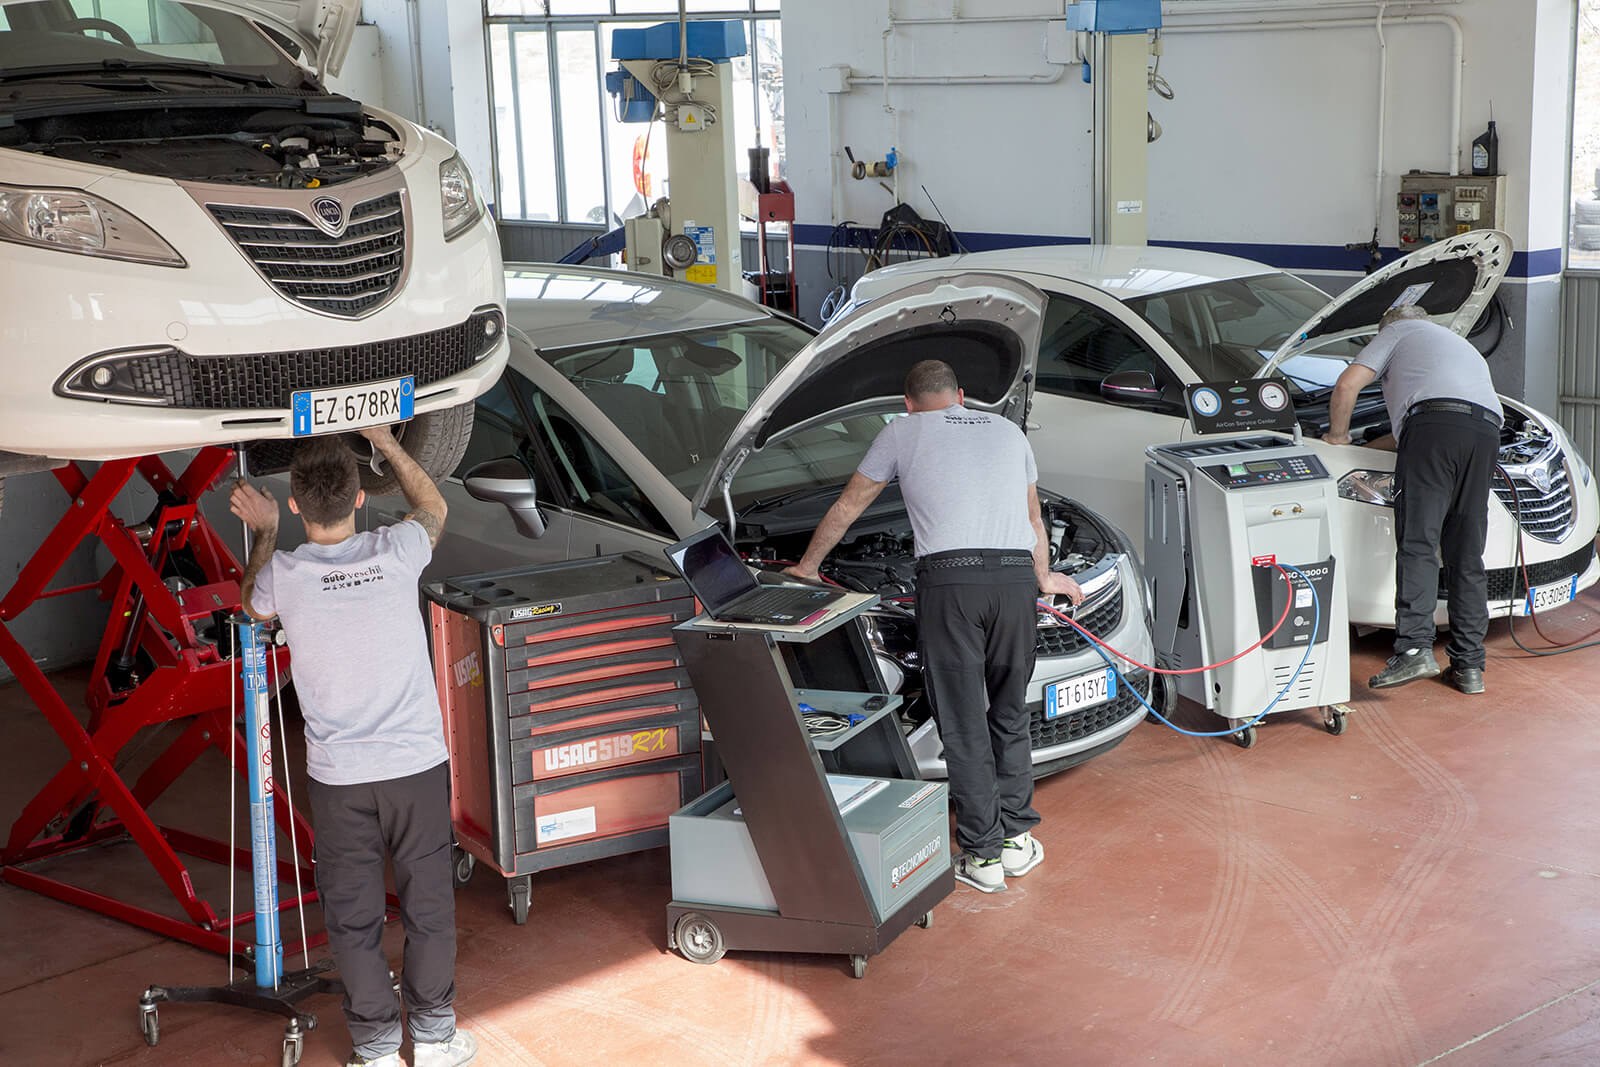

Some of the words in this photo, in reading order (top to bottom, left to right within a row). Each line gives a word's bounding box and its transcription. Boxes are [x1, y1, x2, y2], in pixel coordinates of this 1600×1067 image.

[314, 397, 338, 426] EZ
[345, 386, 400, 421] 678RX
[1534, 590, 1547, 608] ES
[1057, 686, 1071, 708] ET
[1074, 675, 1107, 703] 613YZ
[544, 740, 597, 771] USAG
